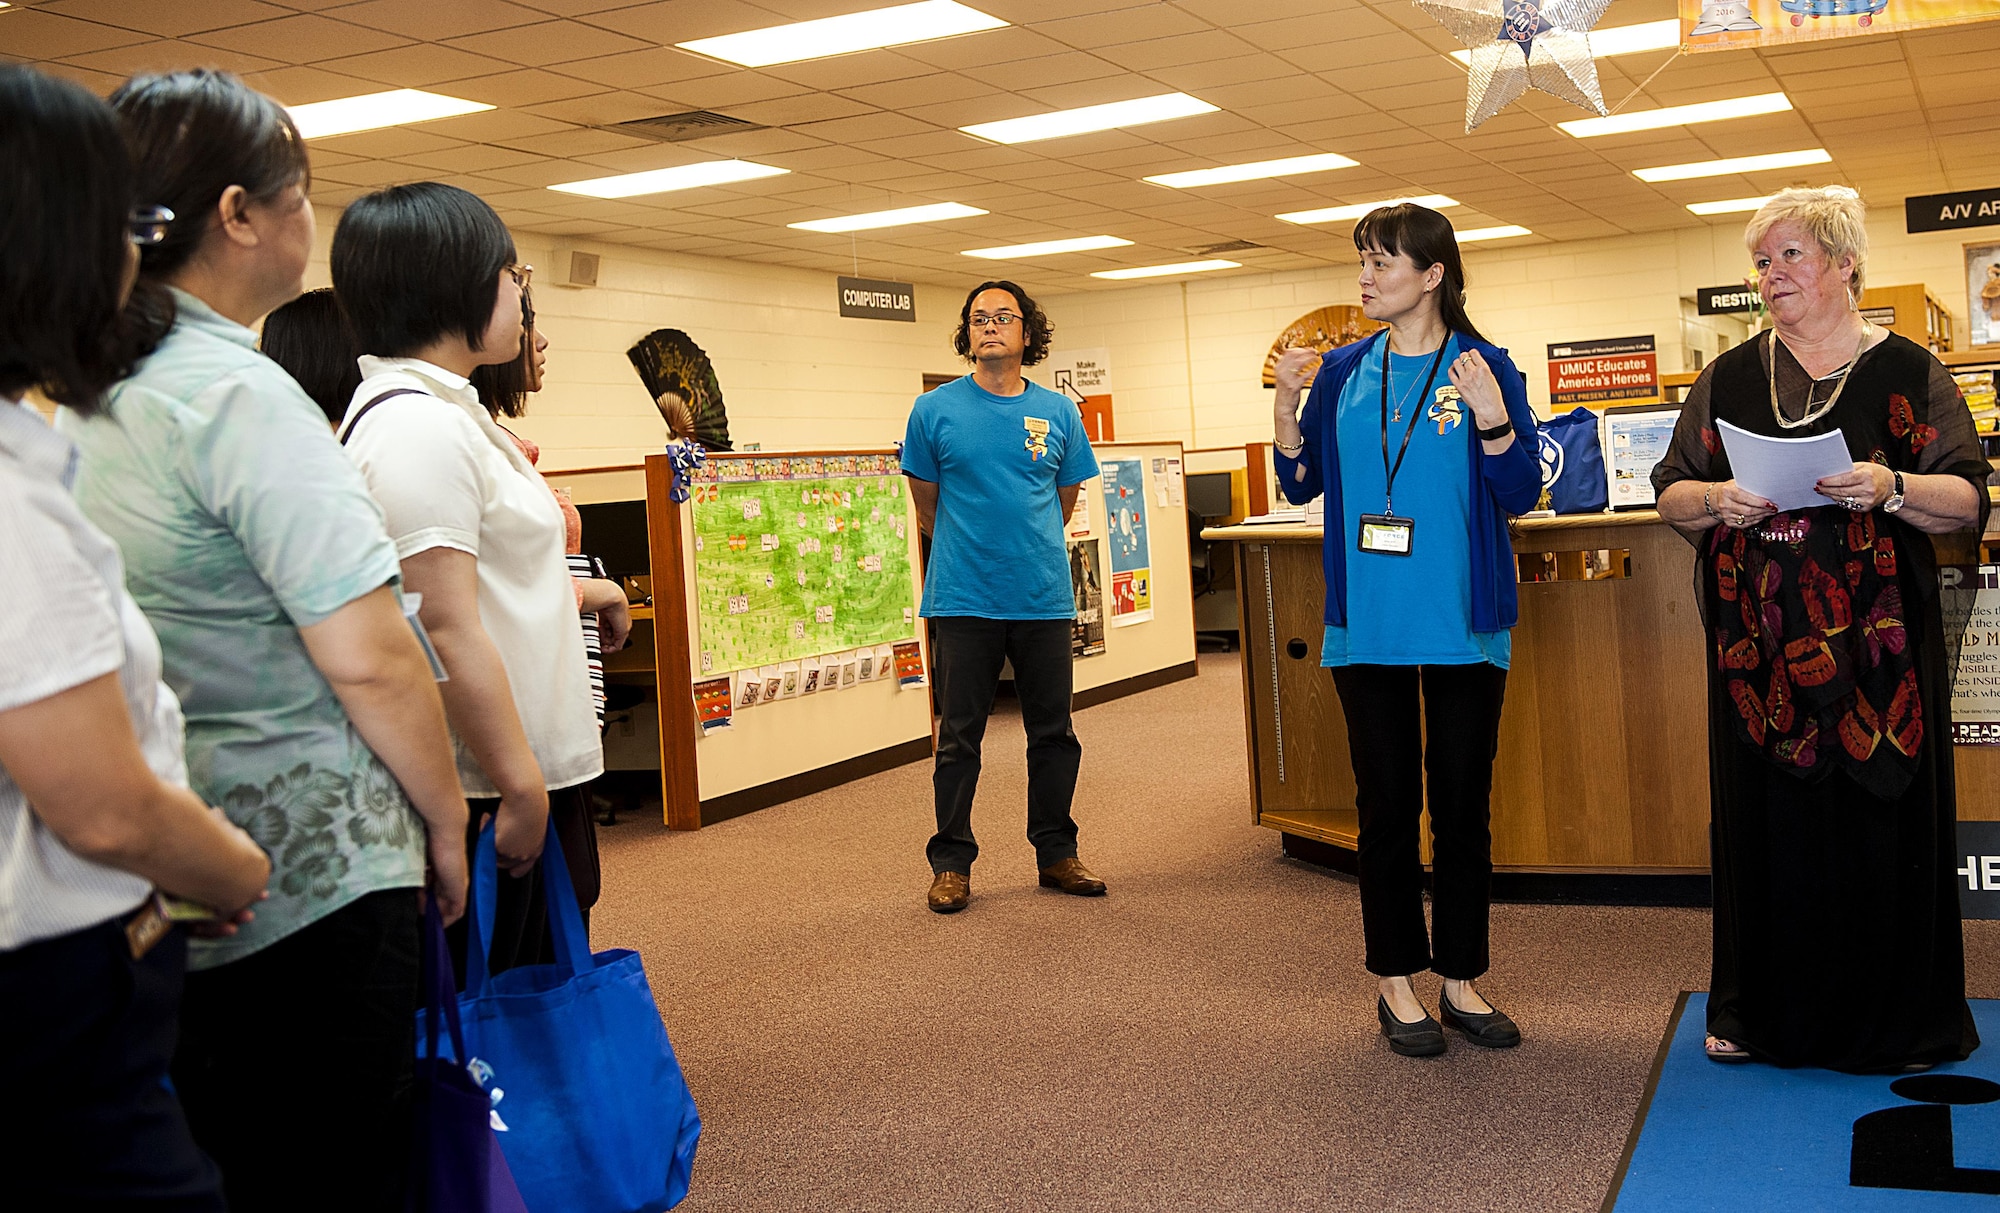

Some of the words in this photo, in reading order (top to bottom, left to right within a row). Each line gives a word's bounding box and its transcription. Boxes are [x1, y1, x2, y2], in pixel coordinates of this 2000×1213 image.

[1716, 8, 1735, 16] 2016
[1940, 203, 1972, 220] A/V
[843, 289, 893, 309] COMPUTER
[893, 294, 911, 310] LAB
[1076, 361, 1096, 369] Make
[1560, 361, 1595, 376] UMUC
[1597, 359, 1647, 373] Educates
[1077, 370, 1088, 378] the
[1089, 369, 1106, 378] right
[1557, 375, 1611, 390] America's
[1612, 372, 1652, 385] Heroes
[1610, 390, 1625, 398] AND
[1626, 388, 1652, 396] FUTURE
[1979, 565, 2000, 589] T
[1976, 618, 1992, 628] the
